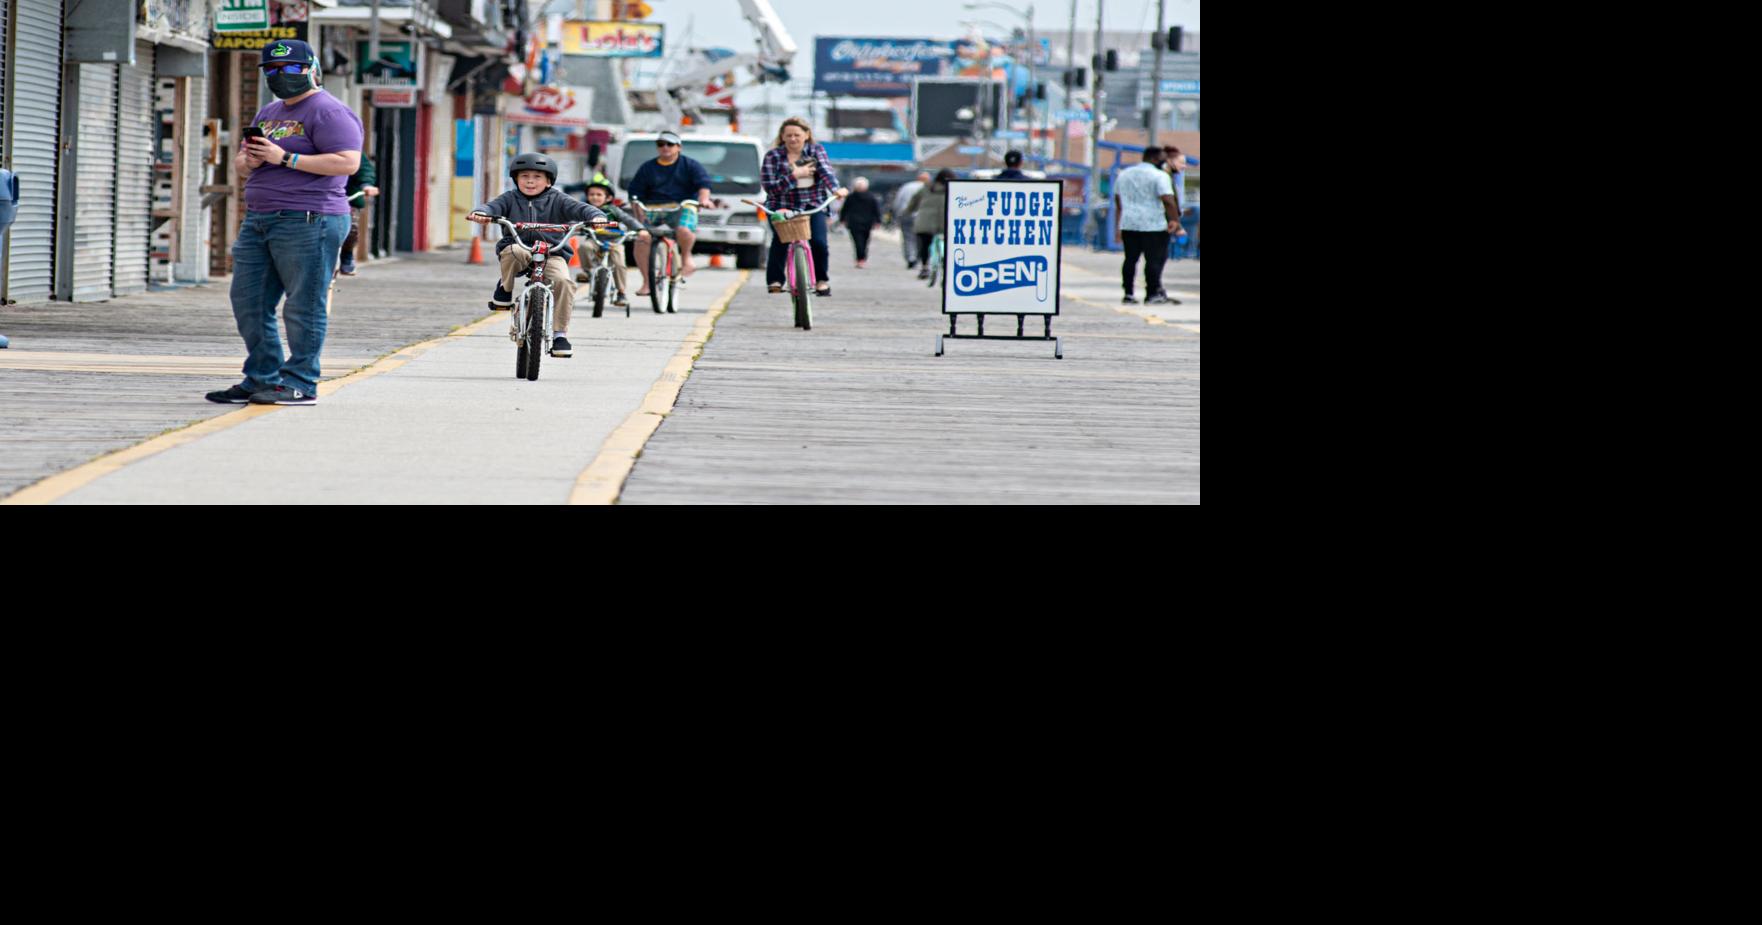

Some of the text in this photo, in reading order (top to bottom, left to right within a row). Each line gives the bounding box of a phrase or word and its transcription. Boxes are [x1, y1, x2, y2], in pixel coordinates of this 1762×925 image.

[986, 191, 1054, 217] FUDGE
[953, 219, 1053, 246] KITCHEN
[955, 261, 1036, 293] OPEN
